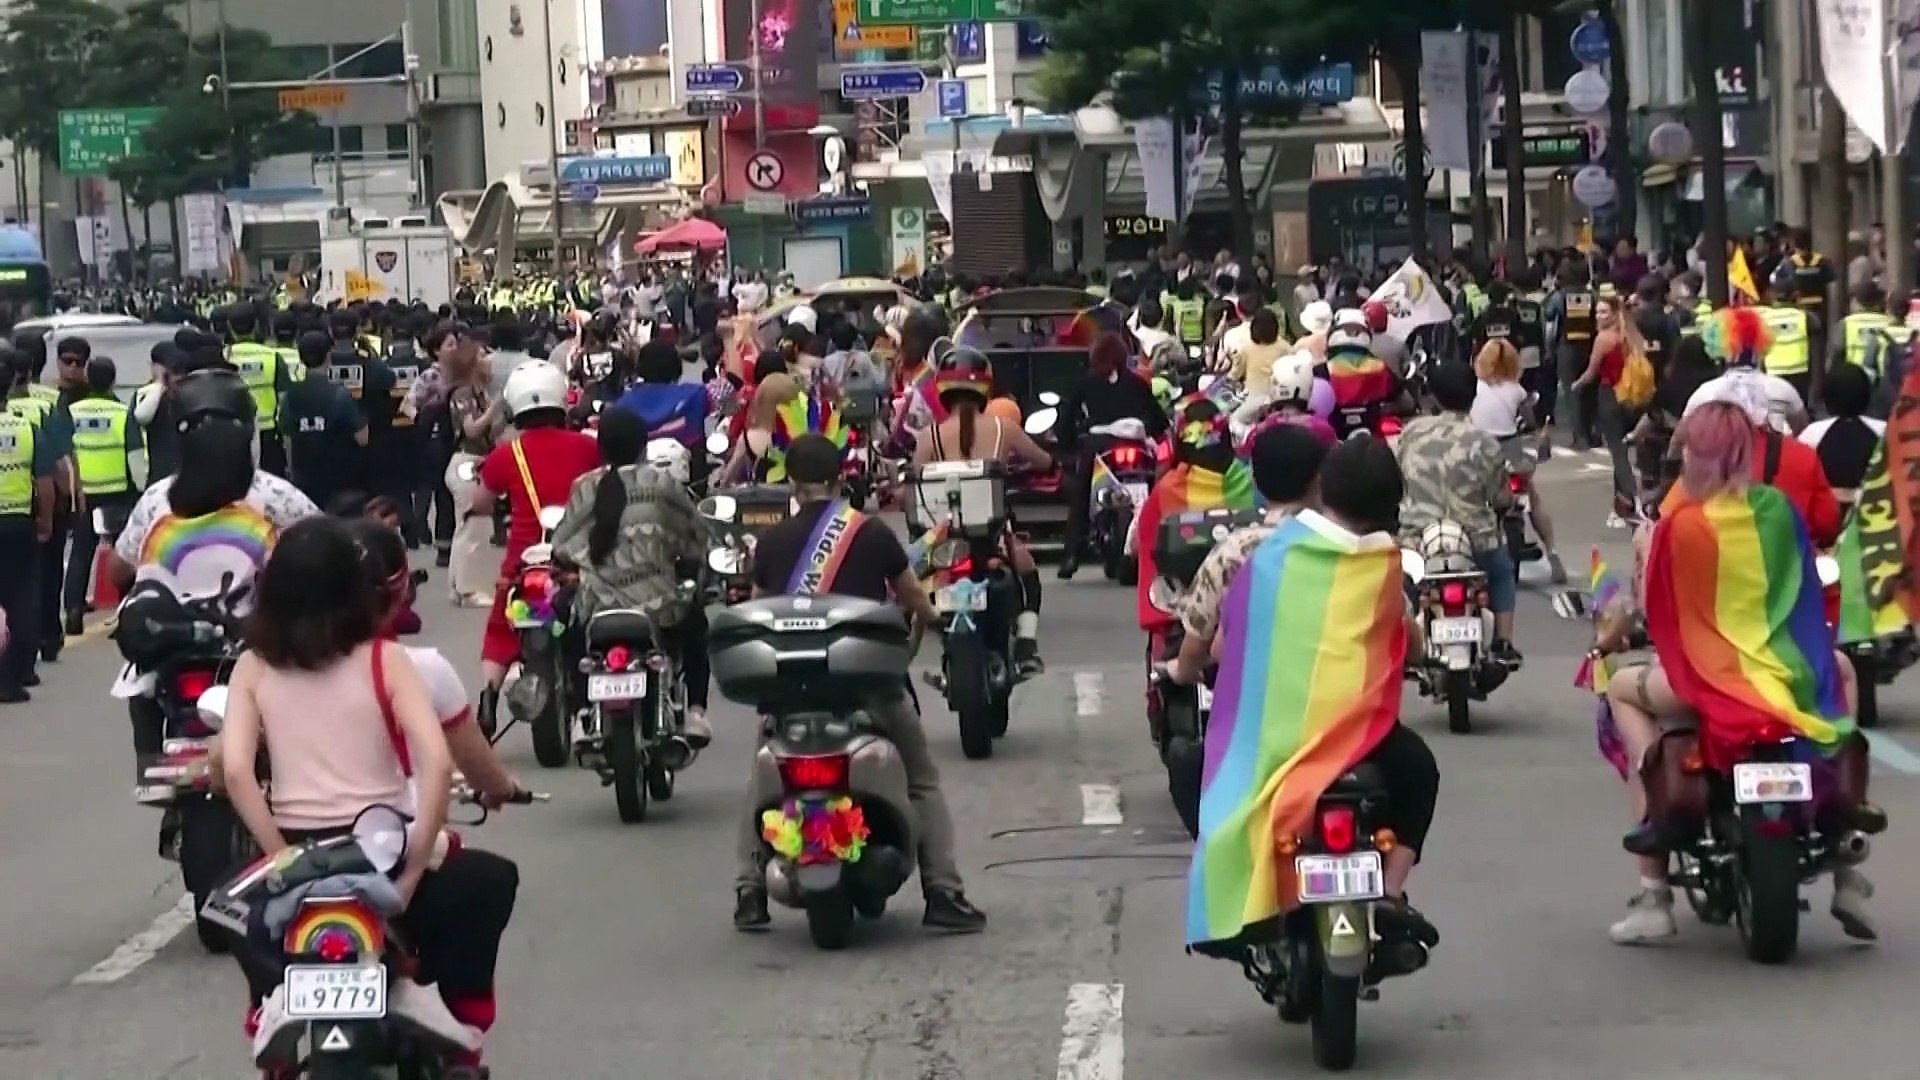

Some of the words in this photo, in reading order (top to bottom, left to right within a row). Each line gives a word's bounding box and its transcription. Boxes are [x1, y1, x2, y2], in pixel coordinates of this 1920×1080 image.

[943, 85, 962, 106] P
[1115, 216, 1168, 235] 있습니
[812, 516, 848, 565] Ride
[313, 986, 377, 1009] 9779
